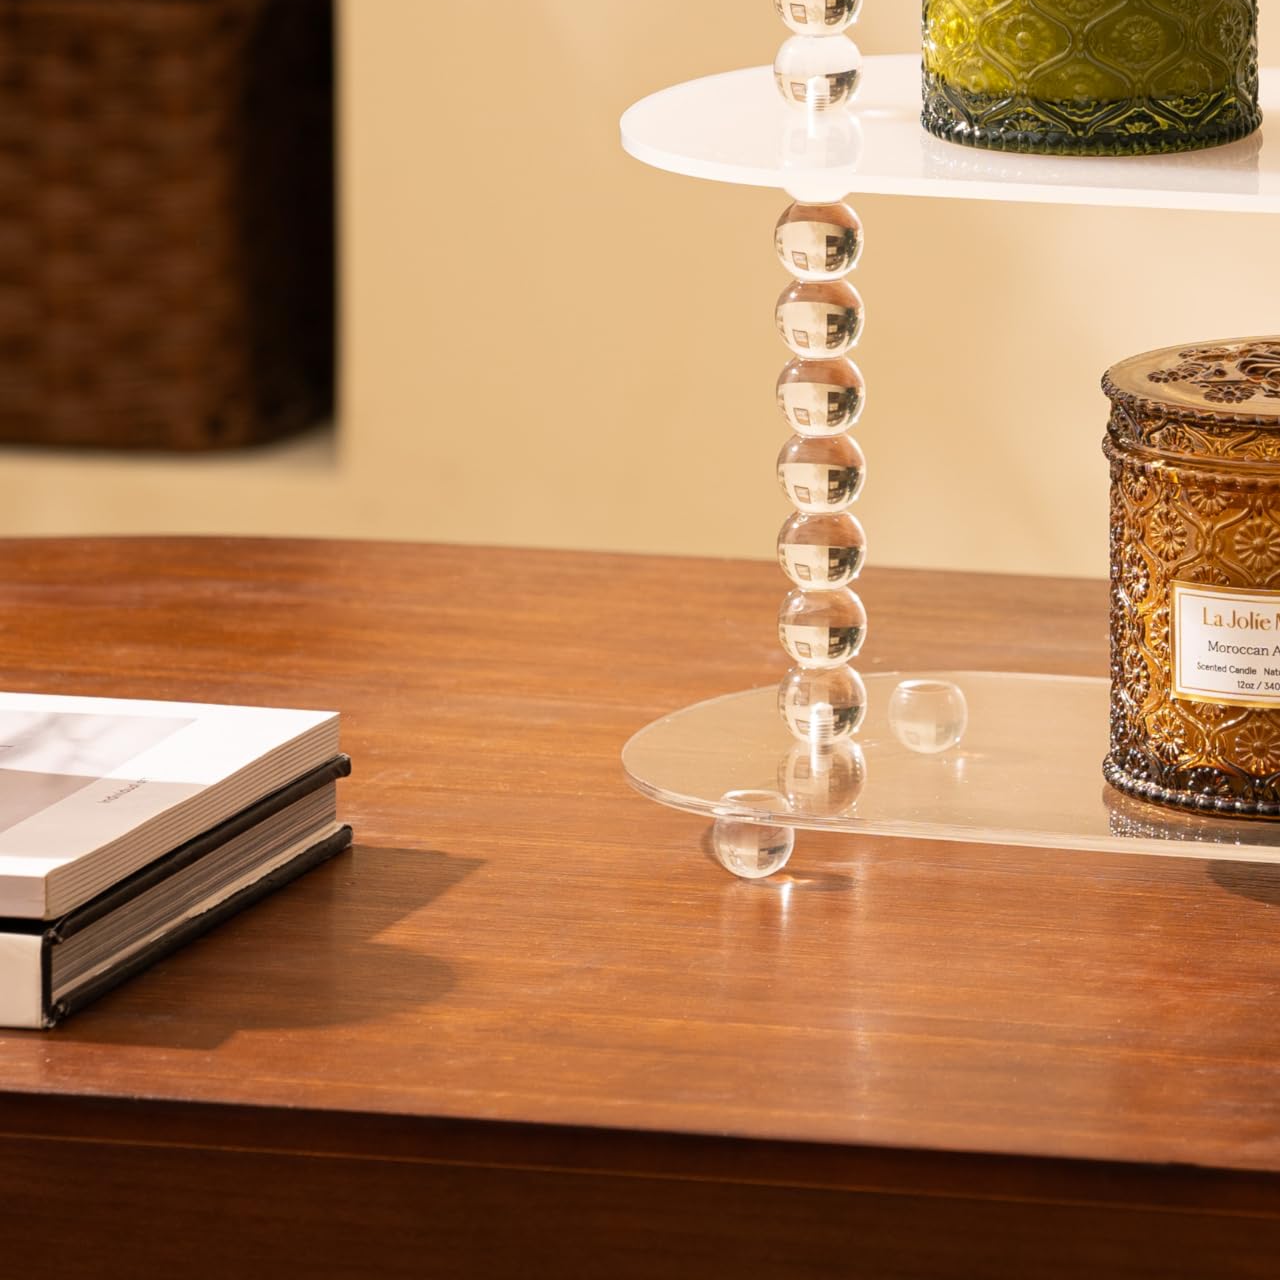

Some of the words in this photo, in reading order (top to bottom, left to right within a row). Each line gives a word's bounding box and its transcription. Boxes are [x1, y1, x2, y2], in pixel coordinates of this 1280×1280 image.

[1203, 607, 1223, 626] La
[1226, 609, 1271, 631] Jolie
[1208, 639, 1269, 656] Moroccan
[1197, 661, 1227, 673] Scented
[1229, 665, 1257, 675] Candle
[1237, 680, 1255, 689] 12oz
